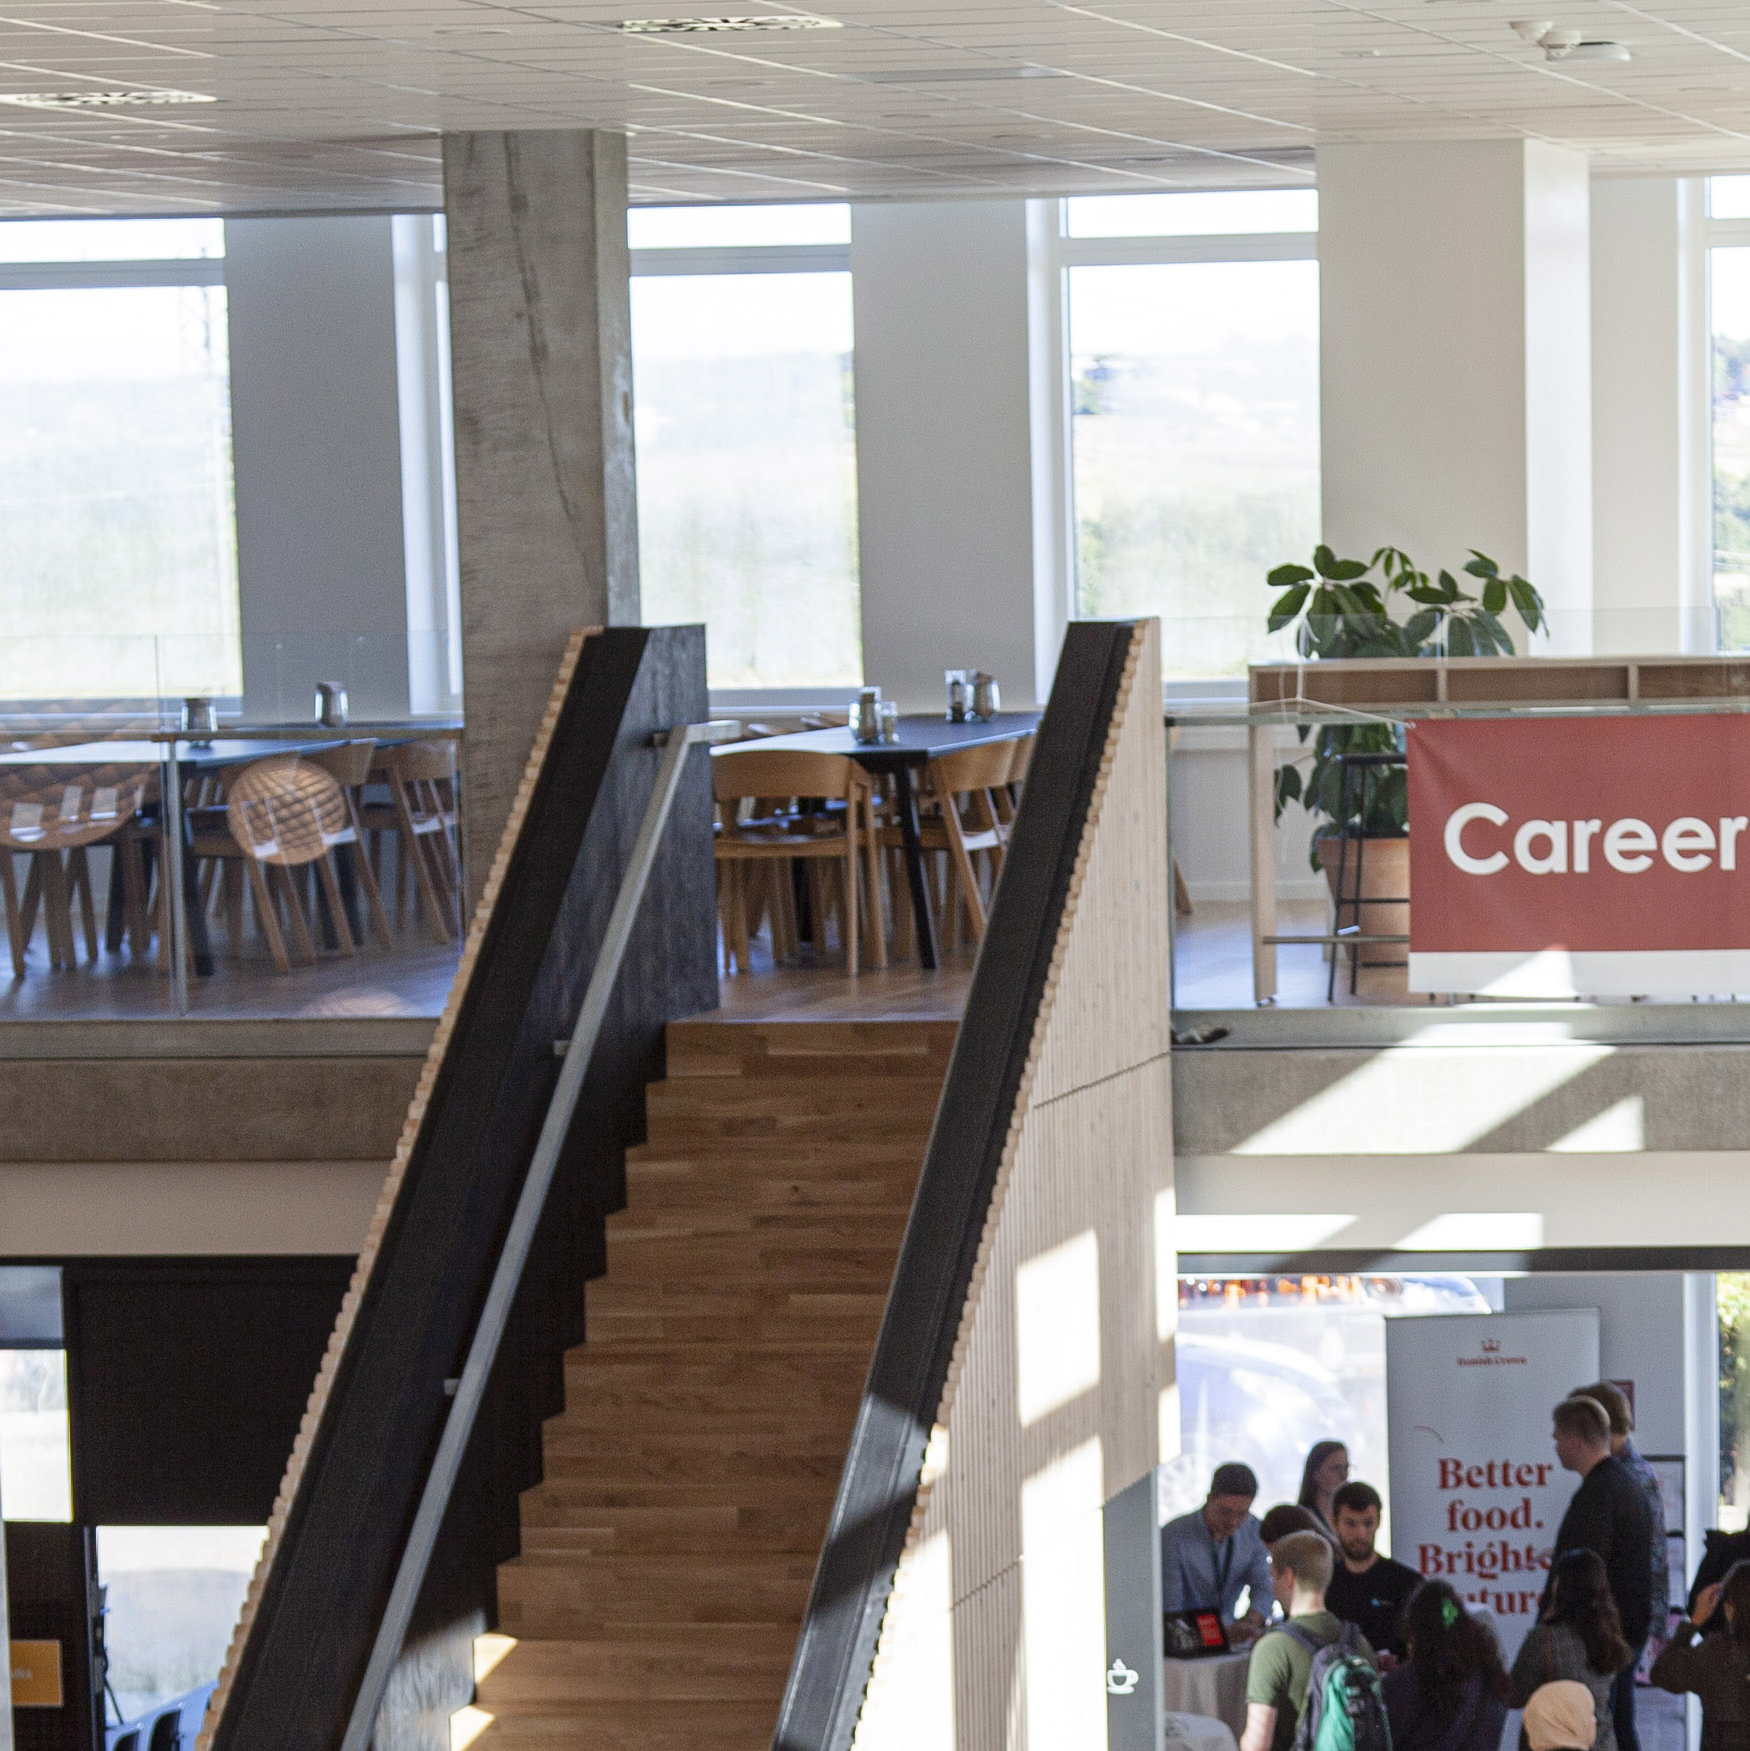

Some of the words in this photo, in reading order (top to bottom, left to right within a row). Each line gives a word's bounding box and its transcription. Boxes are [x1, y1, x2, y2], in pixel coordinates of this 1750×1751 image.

[1444, 802, 1748, 875] Career
[1438, 1457, 1553, 1489] Better
[1447, 1496, 1544, 1532] food.
